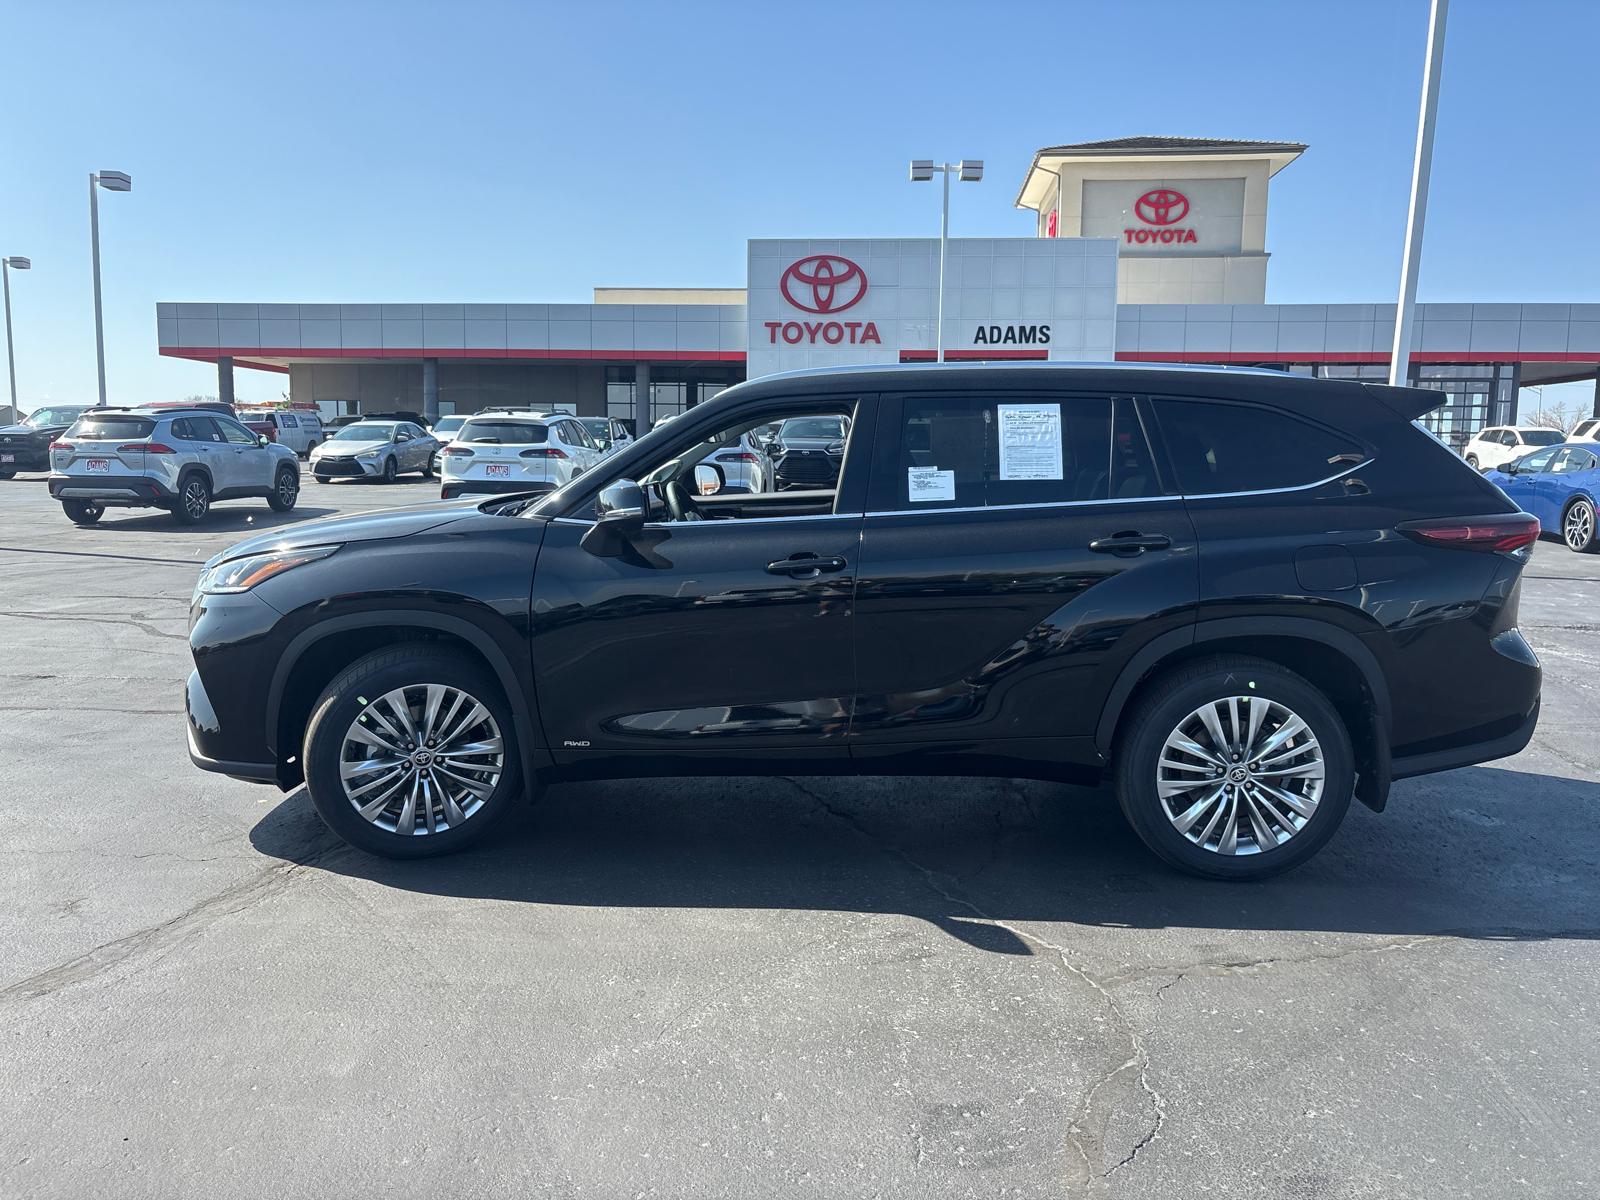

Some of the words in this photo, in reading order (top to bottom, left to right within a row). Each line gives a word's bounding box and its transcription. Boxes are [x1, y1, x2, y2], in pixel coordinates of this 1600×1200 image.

[1123, 229, 1198, 244] TOYOTA
[764, 321, 882, 345] TOYOTA
[973, 325, 1051, 344] ADAMS
[87, 461, 108, 470] ADAMS
[487, 466, 508, 475] ADAMS
